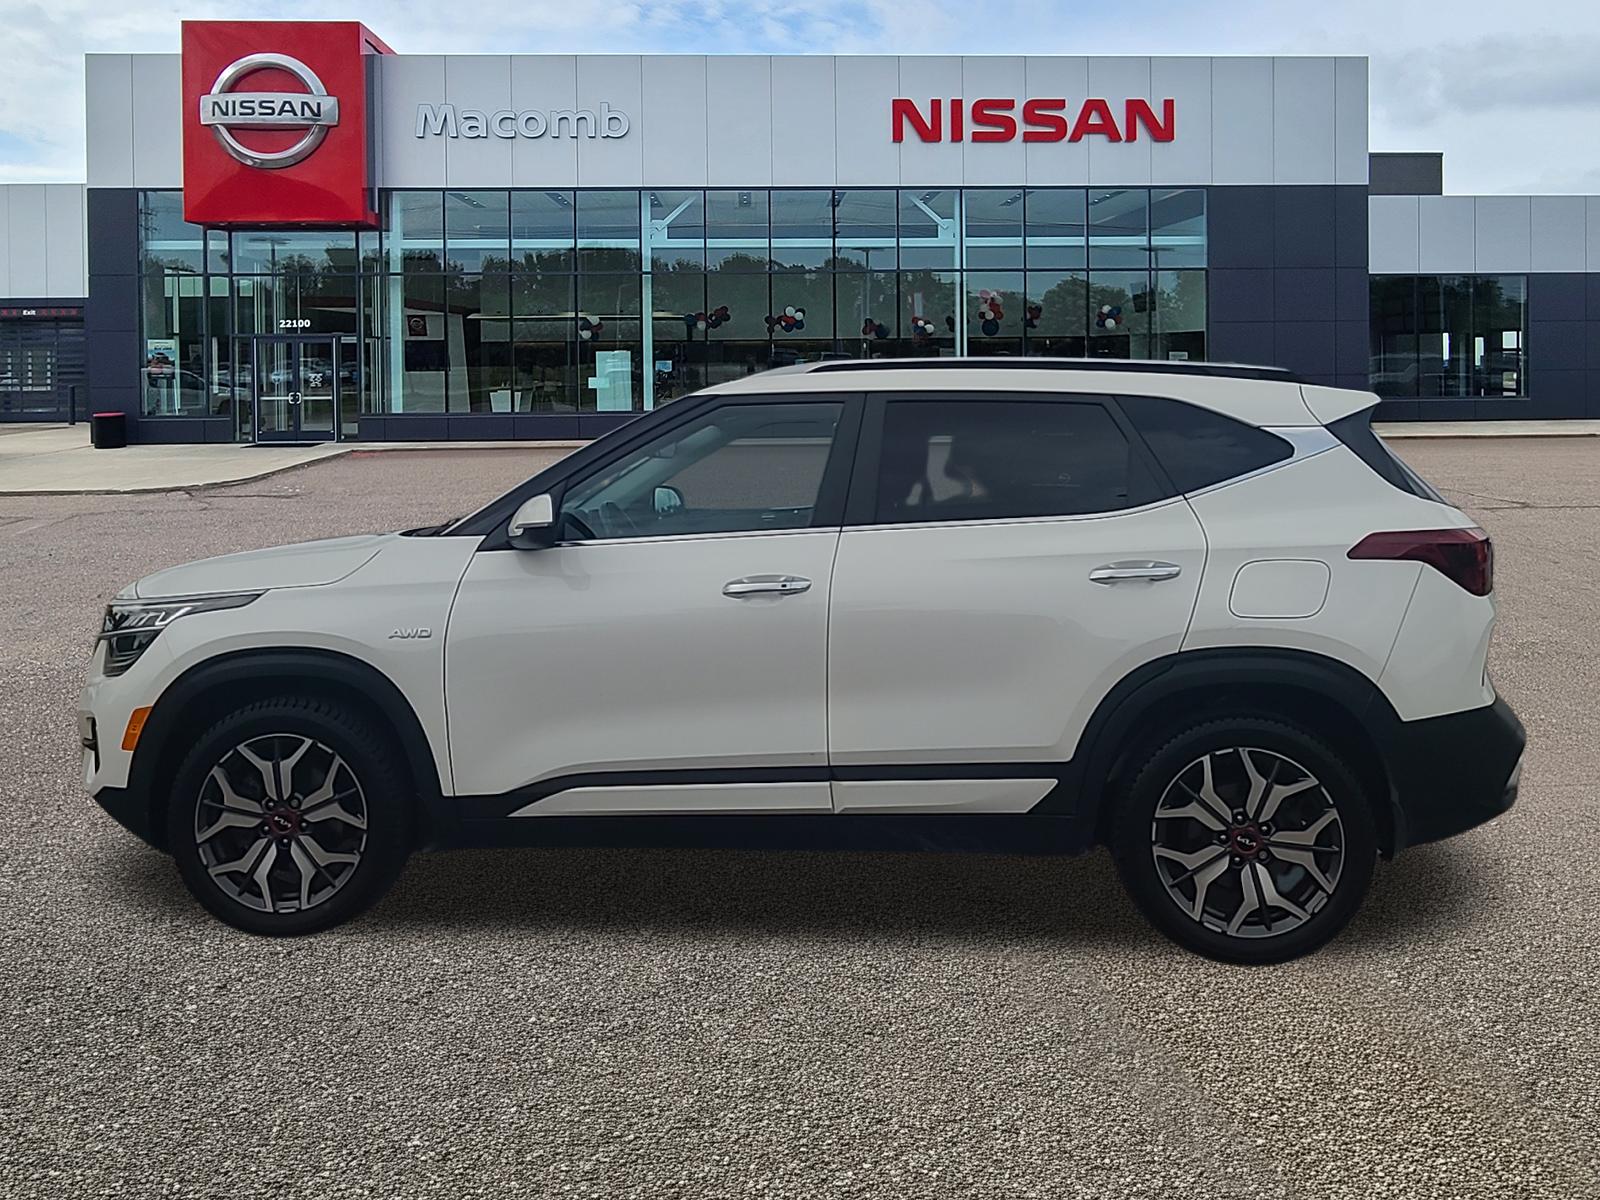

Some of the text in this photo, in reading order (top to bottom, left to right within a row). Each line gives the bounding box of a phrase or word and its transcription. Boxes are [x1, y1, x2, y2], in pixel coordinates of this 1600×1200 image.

[211, 100, 322, 117] NISSAN
[415, 102, 630, 139] Macomb
[892, 98, 1175, 143] NISSAN
[279, 319, 311, 328] 22100
[388, 627, 432, 640] AWD
